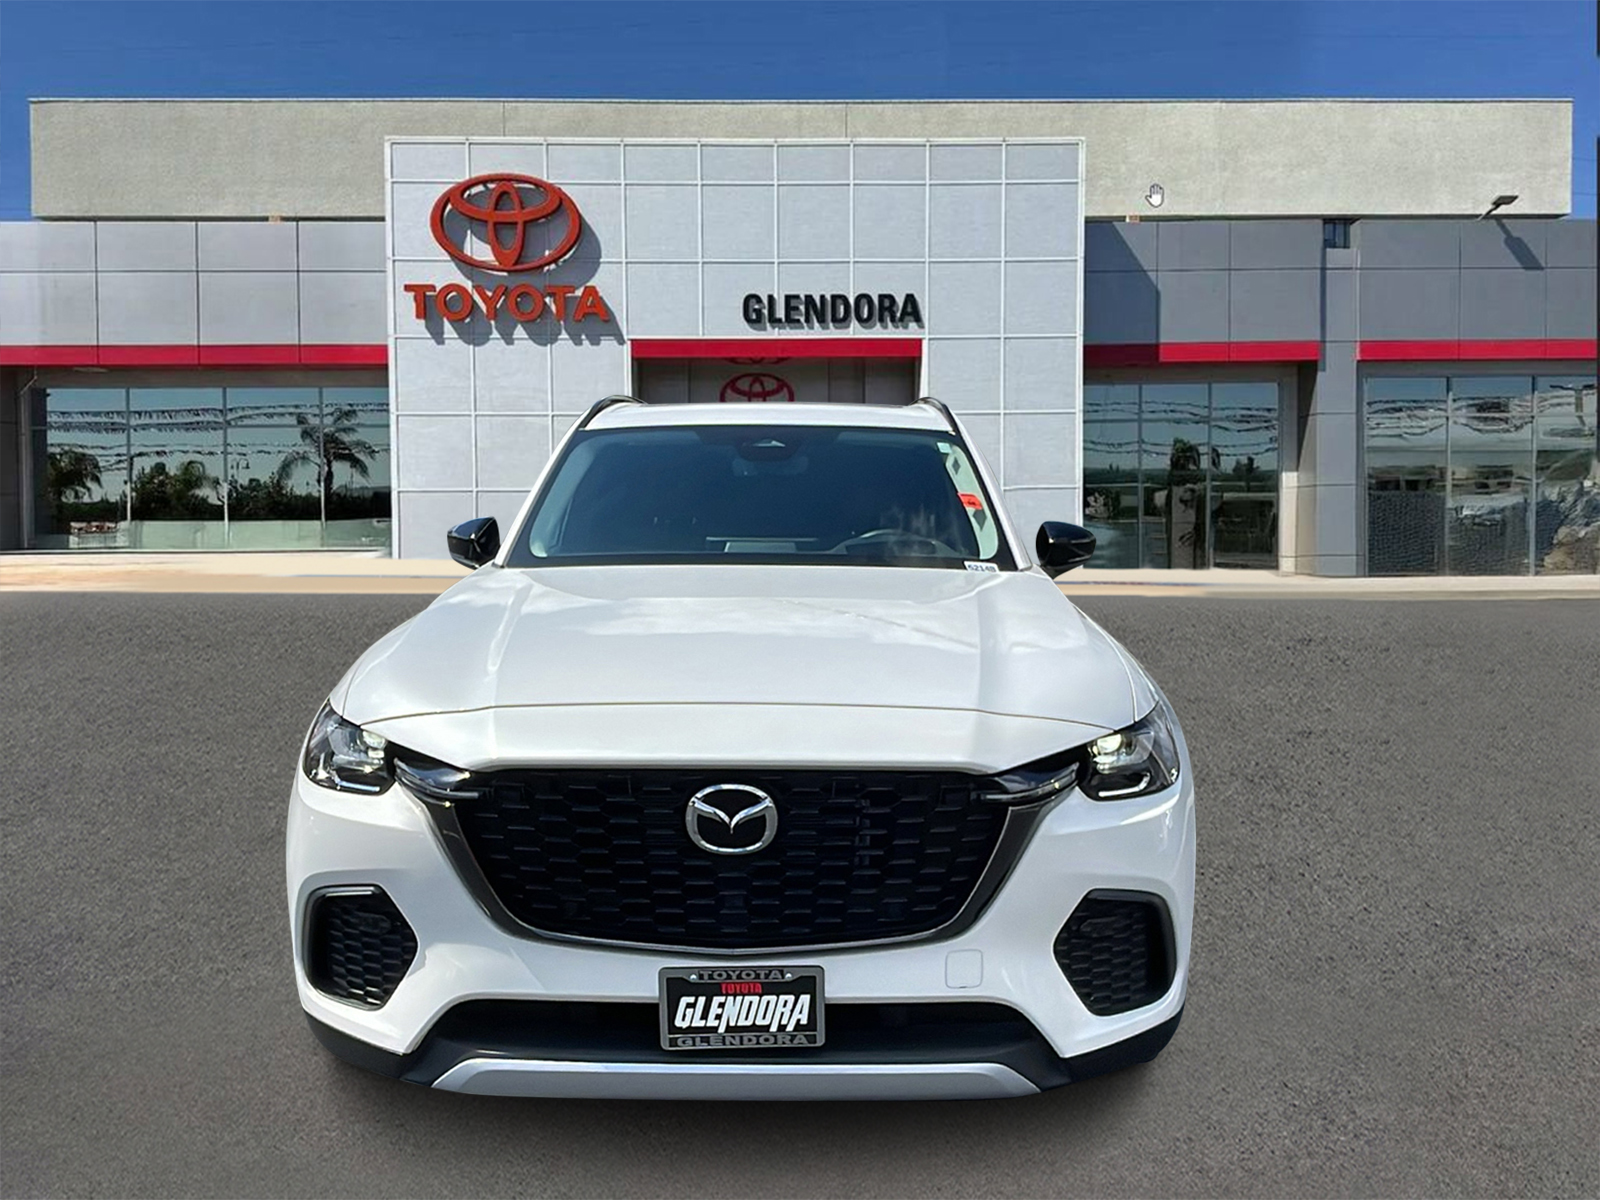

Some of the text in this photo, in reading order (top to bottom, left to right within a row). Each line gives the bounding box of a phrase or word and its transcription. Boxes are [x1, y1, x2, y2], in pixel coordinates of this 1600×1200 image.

[404, 283, 609, 321] TOYOTA
[743, 293, 922, 325] GLENDORA
[699, 970, 782, 980] TOYOTA
[721, 982, 762, 994] TOYOTA
[674, 994, 811, 1033] GLENDORA
[677, 1034, 810, 1047] GLENDORA
